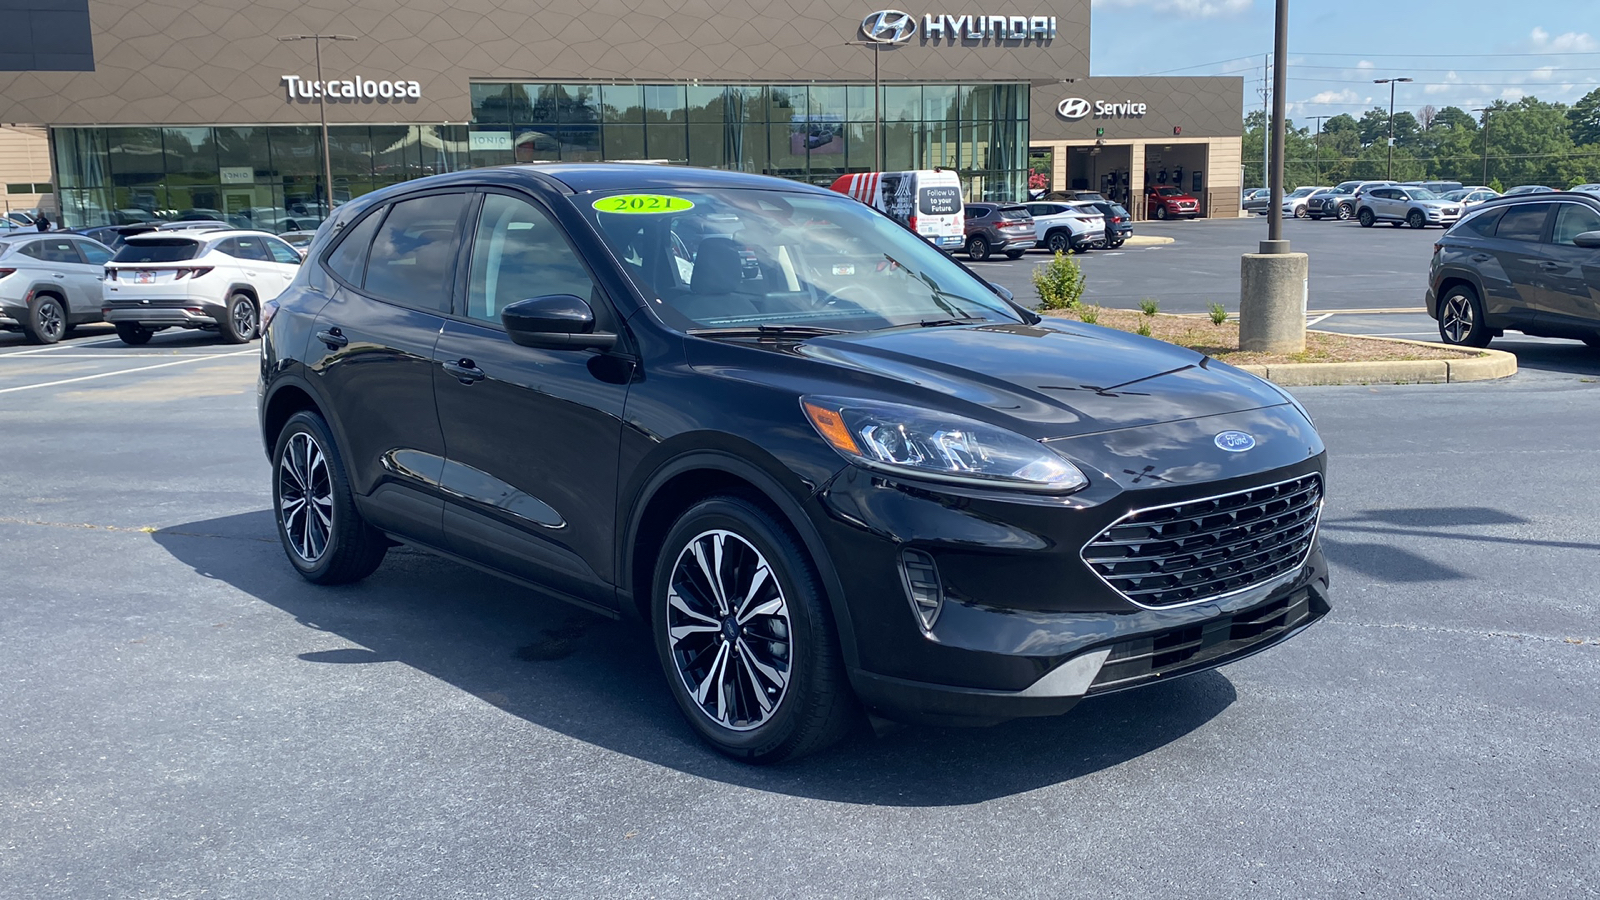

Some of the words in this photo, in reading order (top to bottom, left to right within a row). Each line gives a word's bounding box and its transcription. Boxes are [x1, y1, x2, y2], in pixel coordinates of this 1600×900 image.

[926, 13, 1056, 38] HYUNDAI
[281, 75, 420, 98] Tuscaloosa
[1095, 100, 1146, 115] Service
[614, 198, 672, 211] 2021
[1225, 434, 1248, 447] Ford
